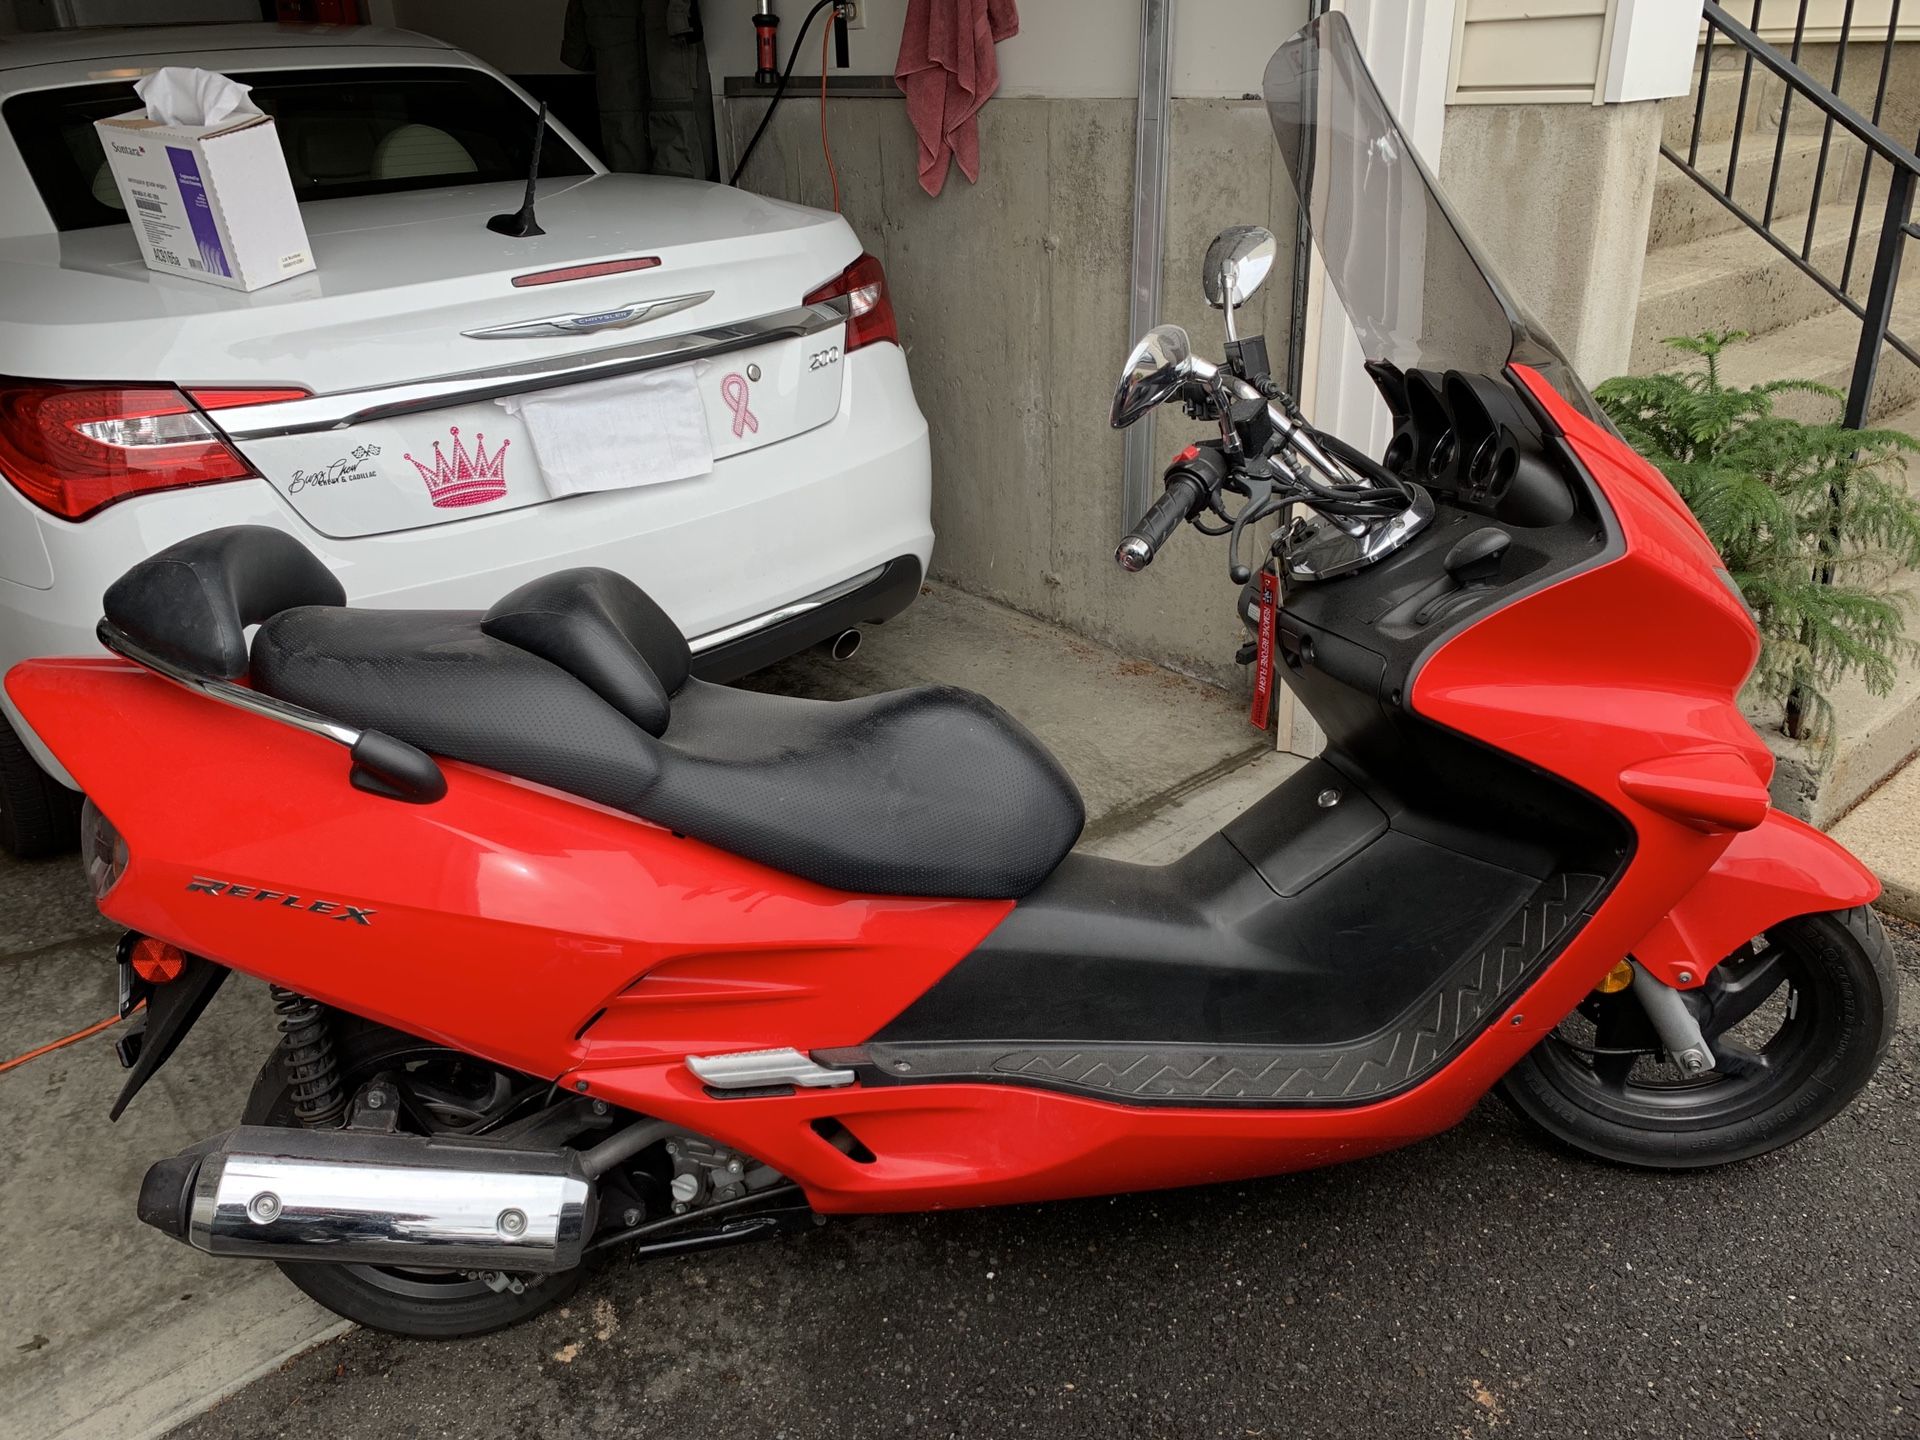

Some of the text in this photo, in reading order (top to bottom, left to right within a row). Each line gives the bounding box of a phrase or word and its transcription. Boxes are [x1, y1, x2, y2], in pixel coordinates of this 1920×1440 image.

[111, 141, 143, 156] Sontara
[578, 311, 628, 324] CHRYSLER
[808, 345, 838, 372] 200
[348, 471, 377, 482] CADILLAC
[1261, 607, 1271, 638] REMOVE
[1260, 638, 1270, 669] BEFORE
[1258, 668, 1269, 694] FLIGHT
[185, 875, 378, 926] REFLEX
